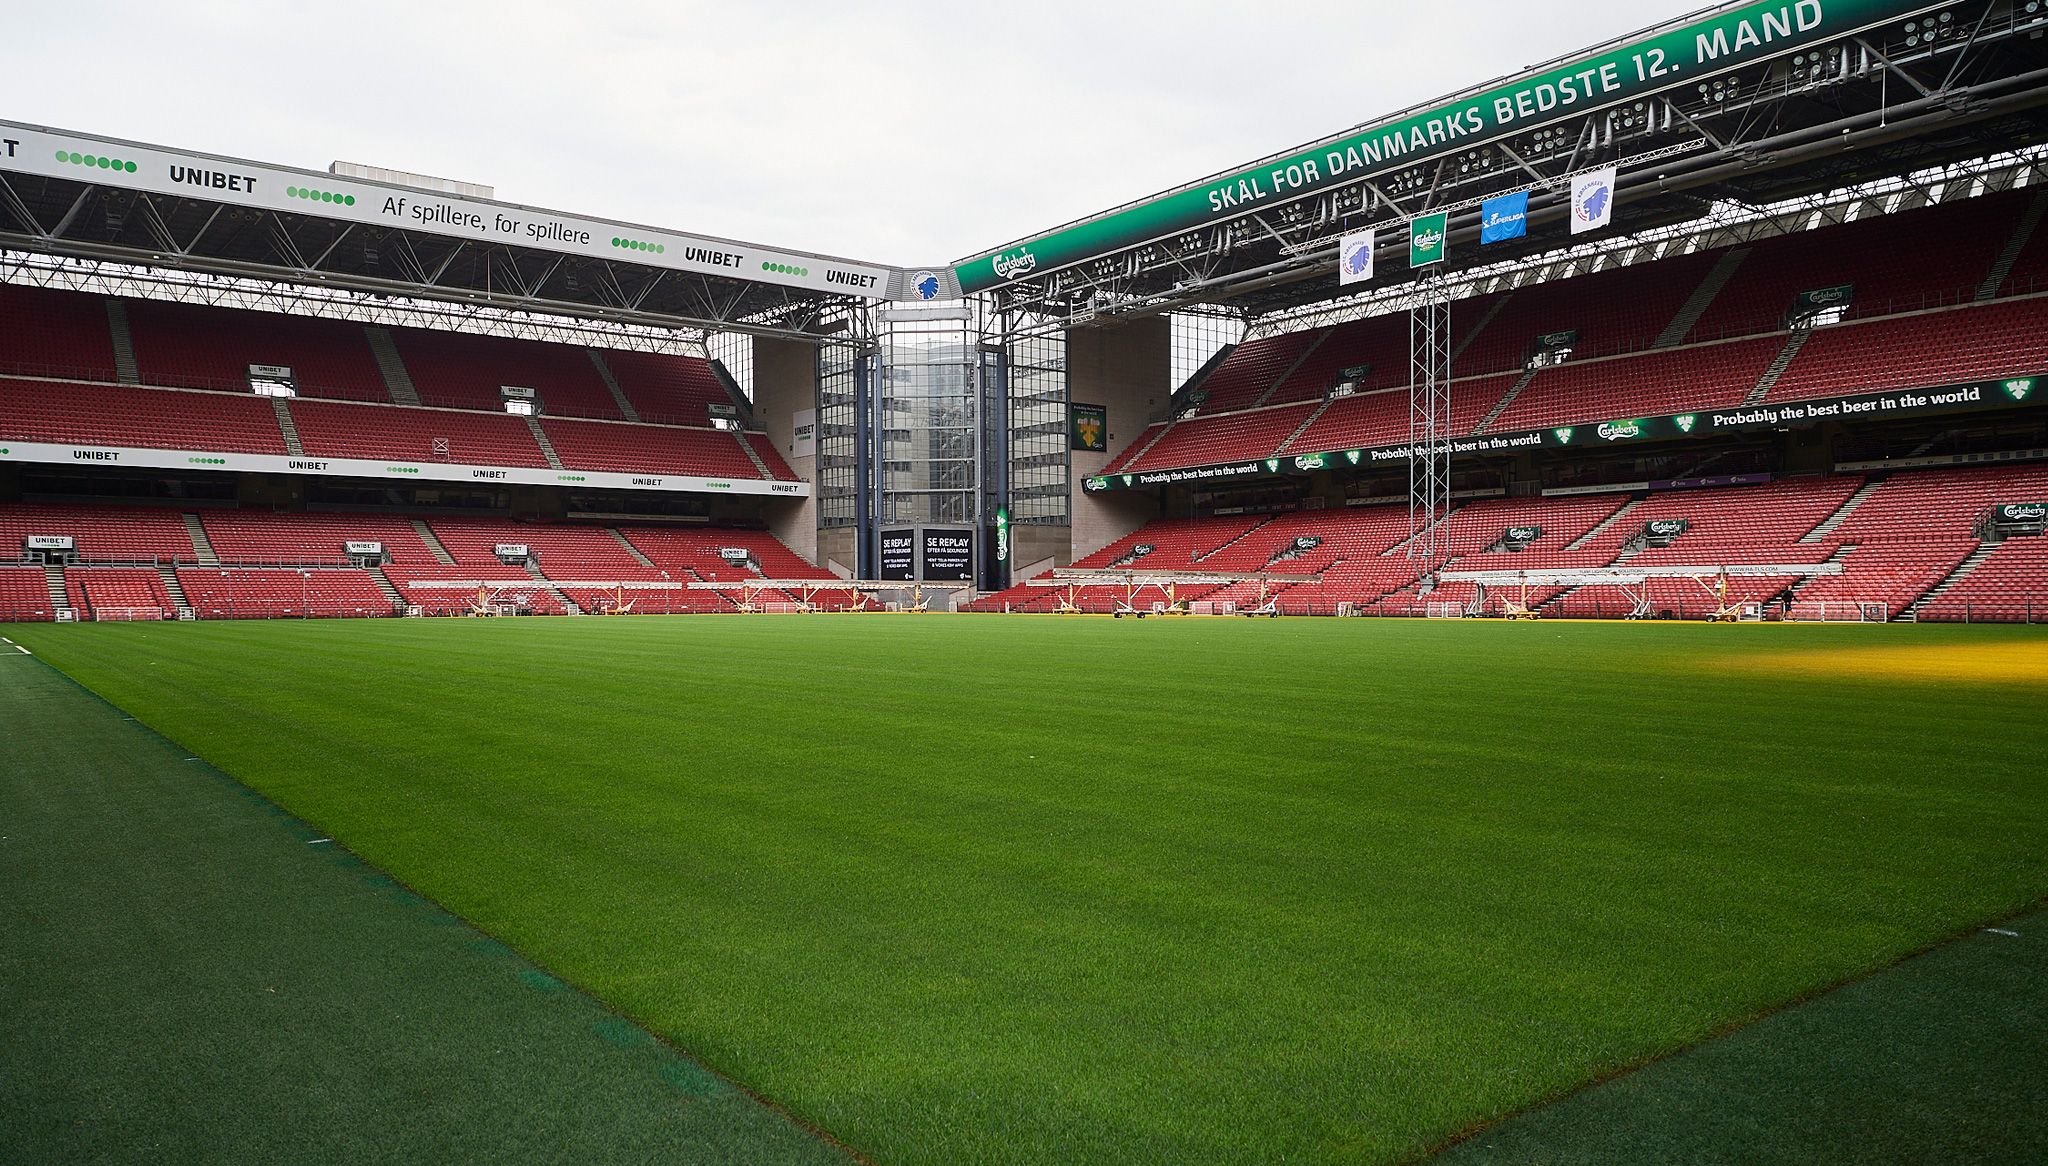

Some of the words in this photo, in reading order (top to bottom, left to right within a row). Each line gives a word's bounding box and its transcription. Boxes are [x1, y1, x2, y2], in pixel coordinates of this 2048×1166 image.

[1208, 177, 1266, 212] SKÅL
[1272, 158, 1320, 193] FOR
[1326, 106, 1484, 177] DANMARKS
[1493, 61, 1621, 125] BEDSTE
[1632, 47, 1680, 82] 12.
[1696, 0, 1823, 63] MAND
[170, 165, 257, 194] UNIBET
[382, 196, 406, 216] Af
[411, 204, 486, 232] spillere,
[495, 213, 521, 233] for
[526, 222, 590, 245] spillere
[1490, 213, 1525, 226] SUPERLIGA
[685, 247, 744, 268] UNIBET
[992, 252, 1036, 279] Carlsberg
[826, 269, 878, 288] UNIBET
[1810, 290, 1842, 303] Carlsberg
[1544, 334, 1569, 345] Carlsberg
[1713, 409, 1778, 427] Probably
[1780, 407, 1804, 420] the
[1806, 403, 1839, 417] best
[1842, 400, 1877, 413] beer
[1880, 397, 1897, 410] in
[1899, 394, 1927, 408] the
[1930, 387, 1981, 404] world
[795, 424, 815, 436] UNIBET
[1597, 423, 1639, 441] Carlsberg
[1454, 441, 1477, 452] beer
[1478, 439, 1490, 450] in
[1490, 436, 1508, 449] the
[1510, 432, 1542, 446] world
[73, 450, 120, 461] UNIBET
[288, 460, 329, 471] UNIBET
[1295, 456, 1324, 471] Carlsberg
[472, 470, 507, 479] UNIBET
[1139, 473, 1171, 483] Probably
[1170, 471, 1182, 481] the
[1182, 470, 1198, 480] best
[1197, 469, 1214, 478] beer
[1214, 467, 1223, 476] in
[1223, 466, 1236, 475] the
[1236, 462, 1259, 474] world
[632, 478, 663, 487] UNIBET
[771, 484, 799, 493] UNIBET
[2004, 504, 2046, 519] Carlsberg
[1651, 521, 1680, 534] Carlsberg
[884, 539, 891, 548] SE
[891, 538, 912, 547] REPLAY
[927, 537, 938, 547] SE
[939, 537, 969, 547] REPLAY
[997, 529, 1007, 560] Carlsberg
